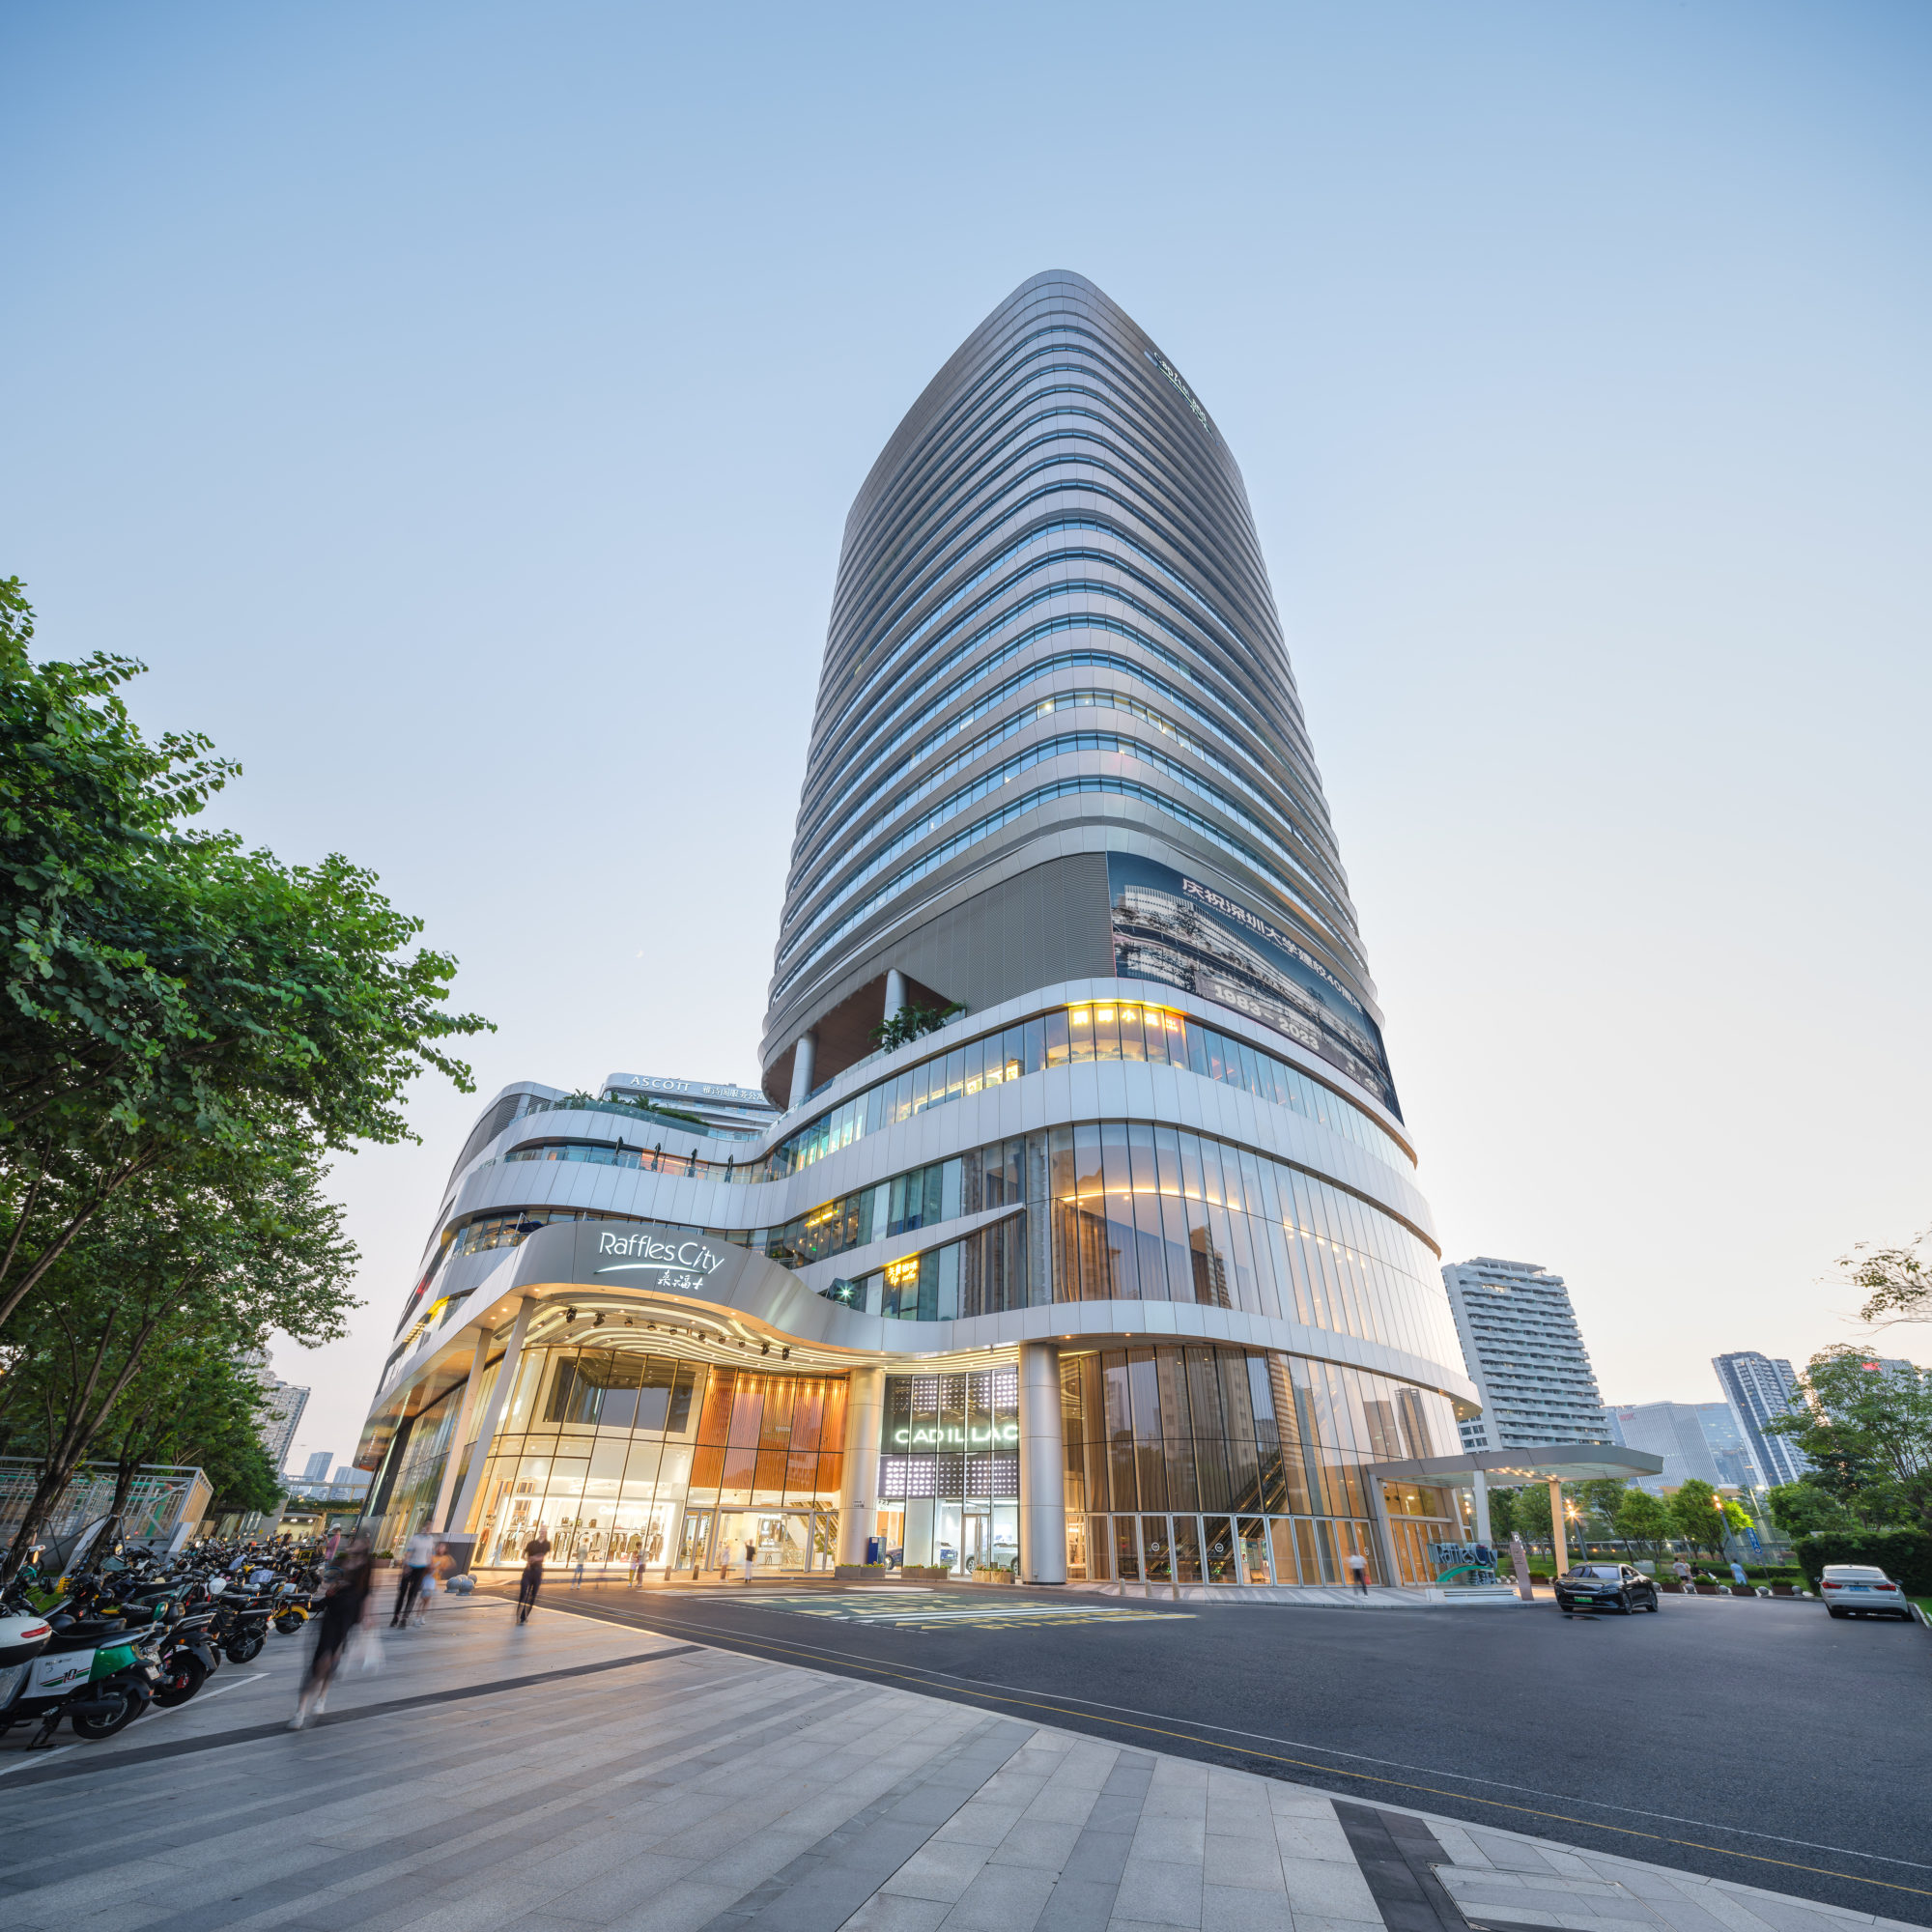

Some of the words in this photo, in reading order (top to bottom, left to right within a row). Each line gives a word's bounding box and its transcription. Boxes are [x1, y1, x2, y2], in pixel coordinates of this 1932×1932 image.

[1214, 984, 1262, 1017] 1983
[1278, 1016, 1320, 1050] 2023
[630, 1076, 692, 1092] ASCOTT
[599, 1232, 675, 1262] Raffles
[677, 1242, 724, 1274] City
[895, 1424, 1018, 1444] CADILLAC
[1435, 1543, 1476, 1564] Raffles
